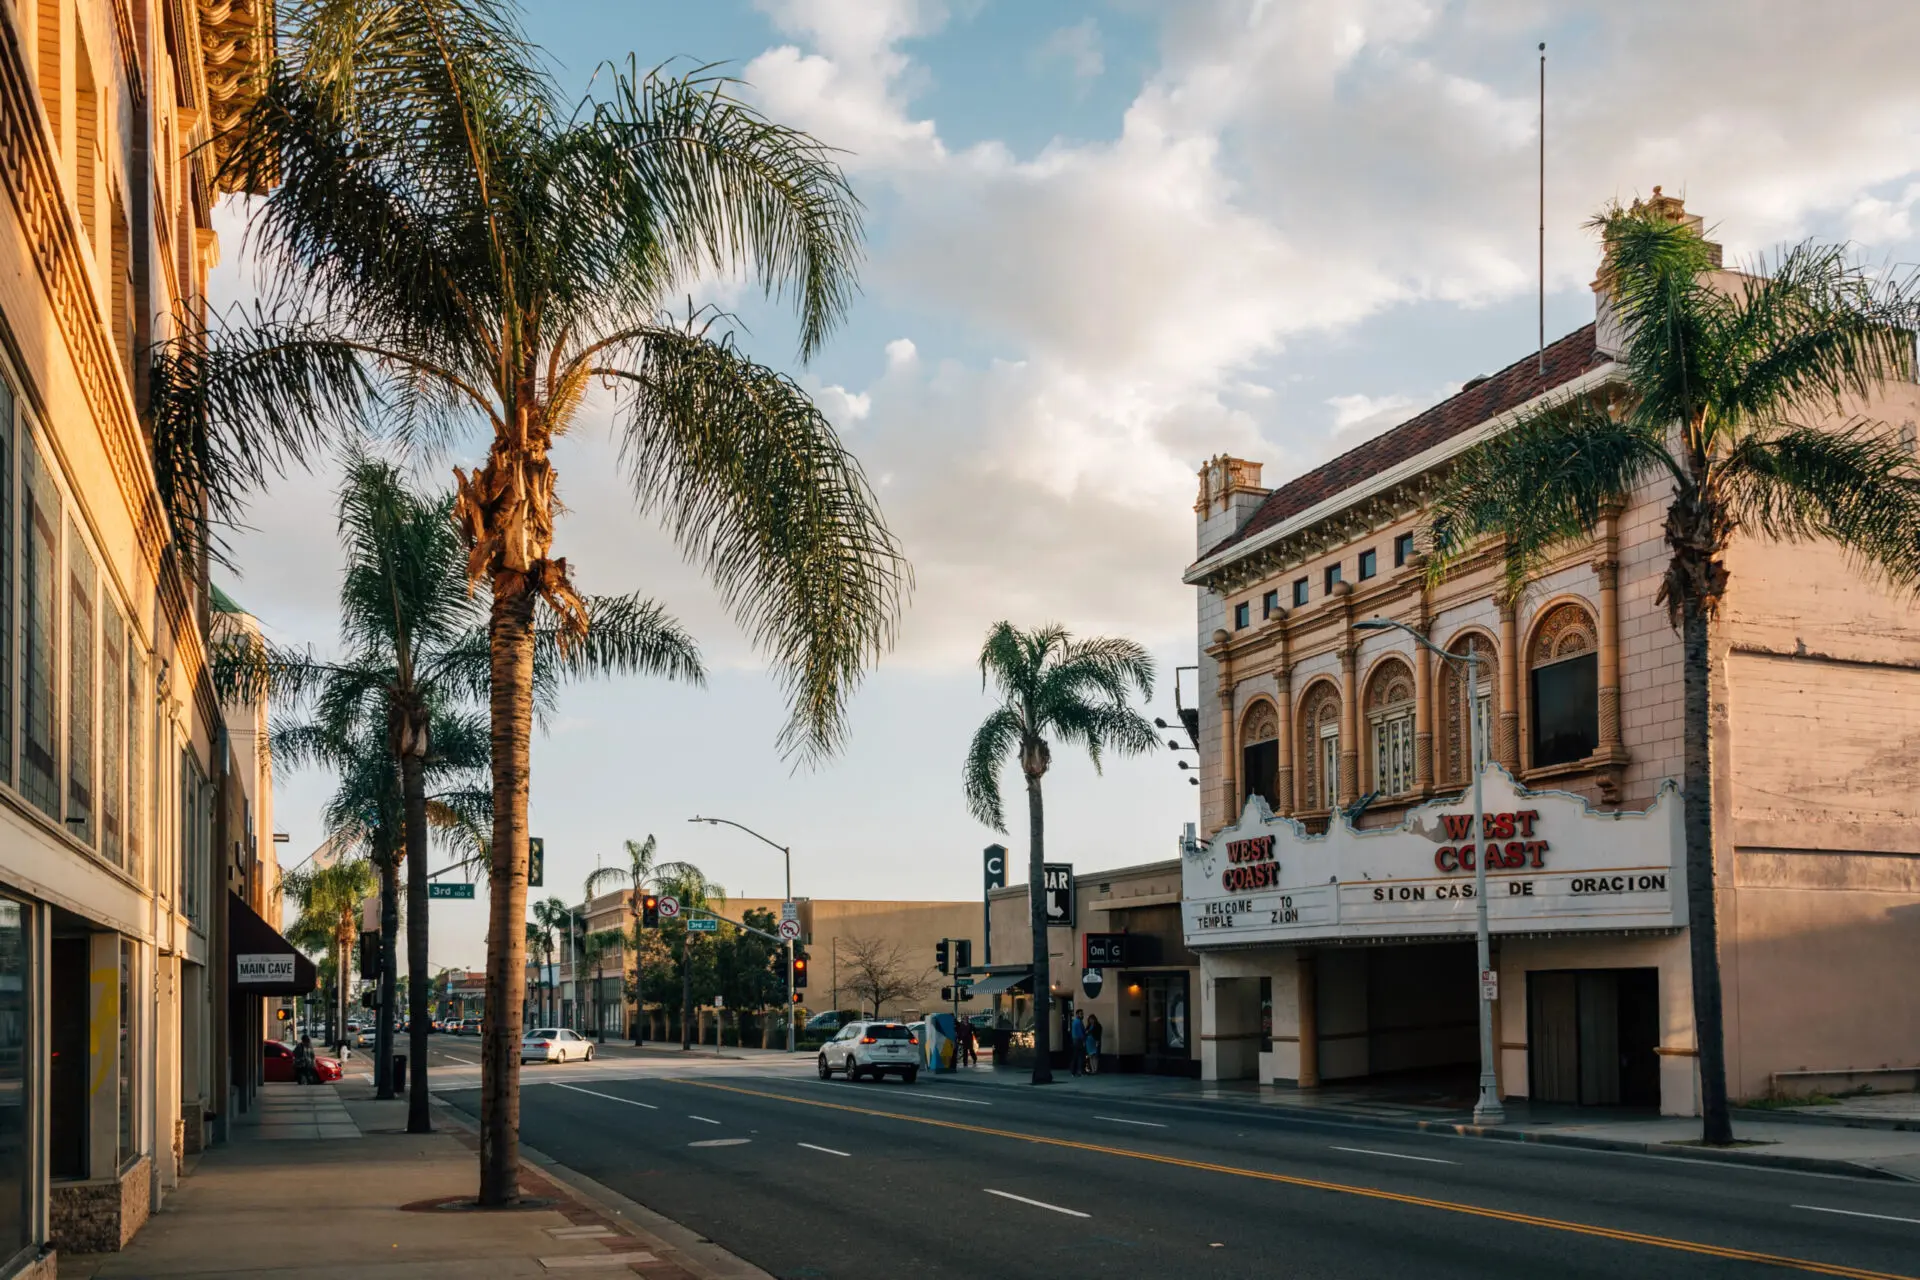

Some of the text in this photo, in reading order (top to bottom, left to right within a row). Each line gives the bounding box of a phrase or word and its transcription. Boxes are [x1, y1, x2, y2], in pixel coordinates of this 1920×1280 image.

[1226, 835, 1276, 863] WEST
[1435, 840, 1549, 872] COAST
[1222, 862, 1280, 891] COAST
[433, 886, 452, 896] 3rd
[1373, 875, 1665, 901] SION CAS DE ORACION
[1205, 896, 1292, 915] WELCOME TO
[1197, 908, 1298, 929] TEMPLE ZION
[1090, 945, 1120, 956] Om G
[240, 962, 293, 975] MAIN CAVE
